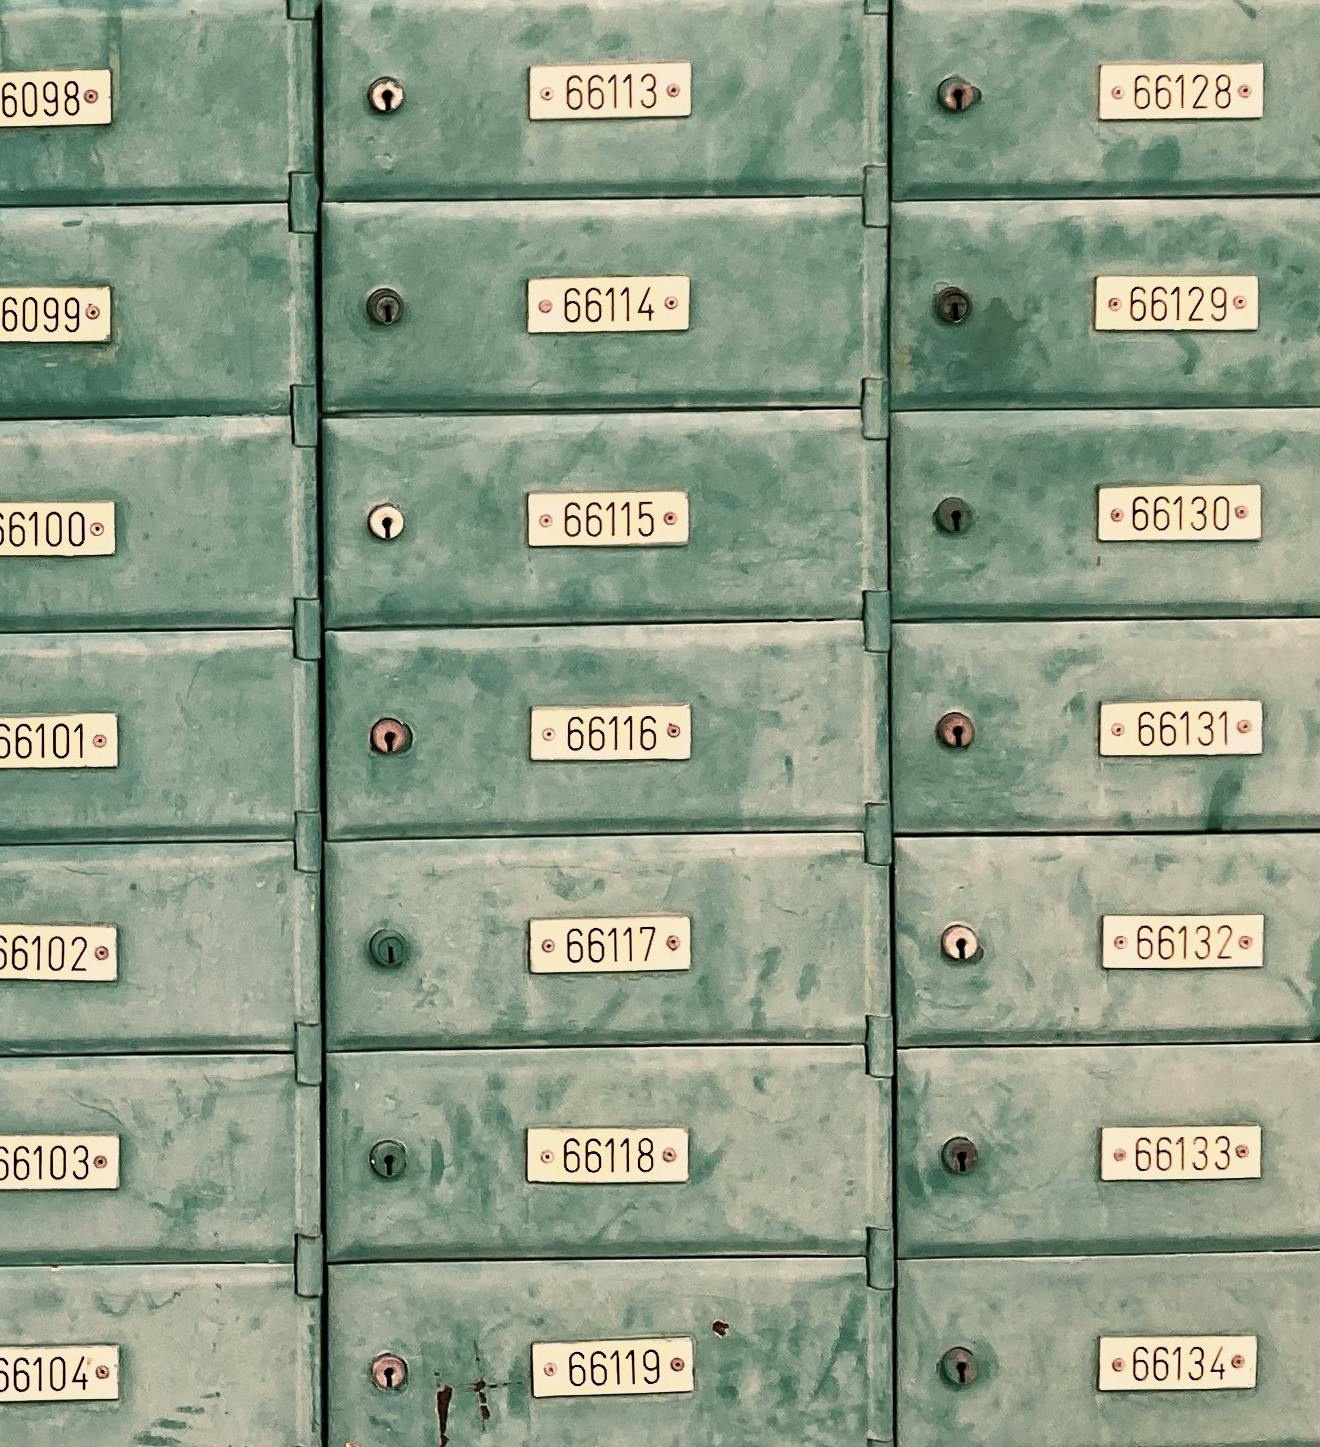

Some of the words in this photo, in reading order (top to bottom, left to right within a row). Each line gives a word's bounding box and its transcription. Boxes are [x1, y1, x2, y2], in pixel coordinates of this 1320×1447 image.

[566, 73, 657, 111] 66113
[1134, 73, 1232, 110] 66128
[563, 286, 655, 324] 66114
[1129, 286, 1228, 322] 66129
[564, 501, 655, 538] 66115
[1132, 495, 1230, 532] 66130
[567, 715, 657, 752] 66116
[1137, 710, 1228, 747] 66131
[566, 926, 656, 964] 66117
[1136, 924, 1233, 961] 66132
[563, 1137, 654, 1174] 66118
[1135, 1135, 1231, 1172] 66133
[568, 1348, 661, 1387] 66119
[1132, 1346, 1228, 1382] 66134
